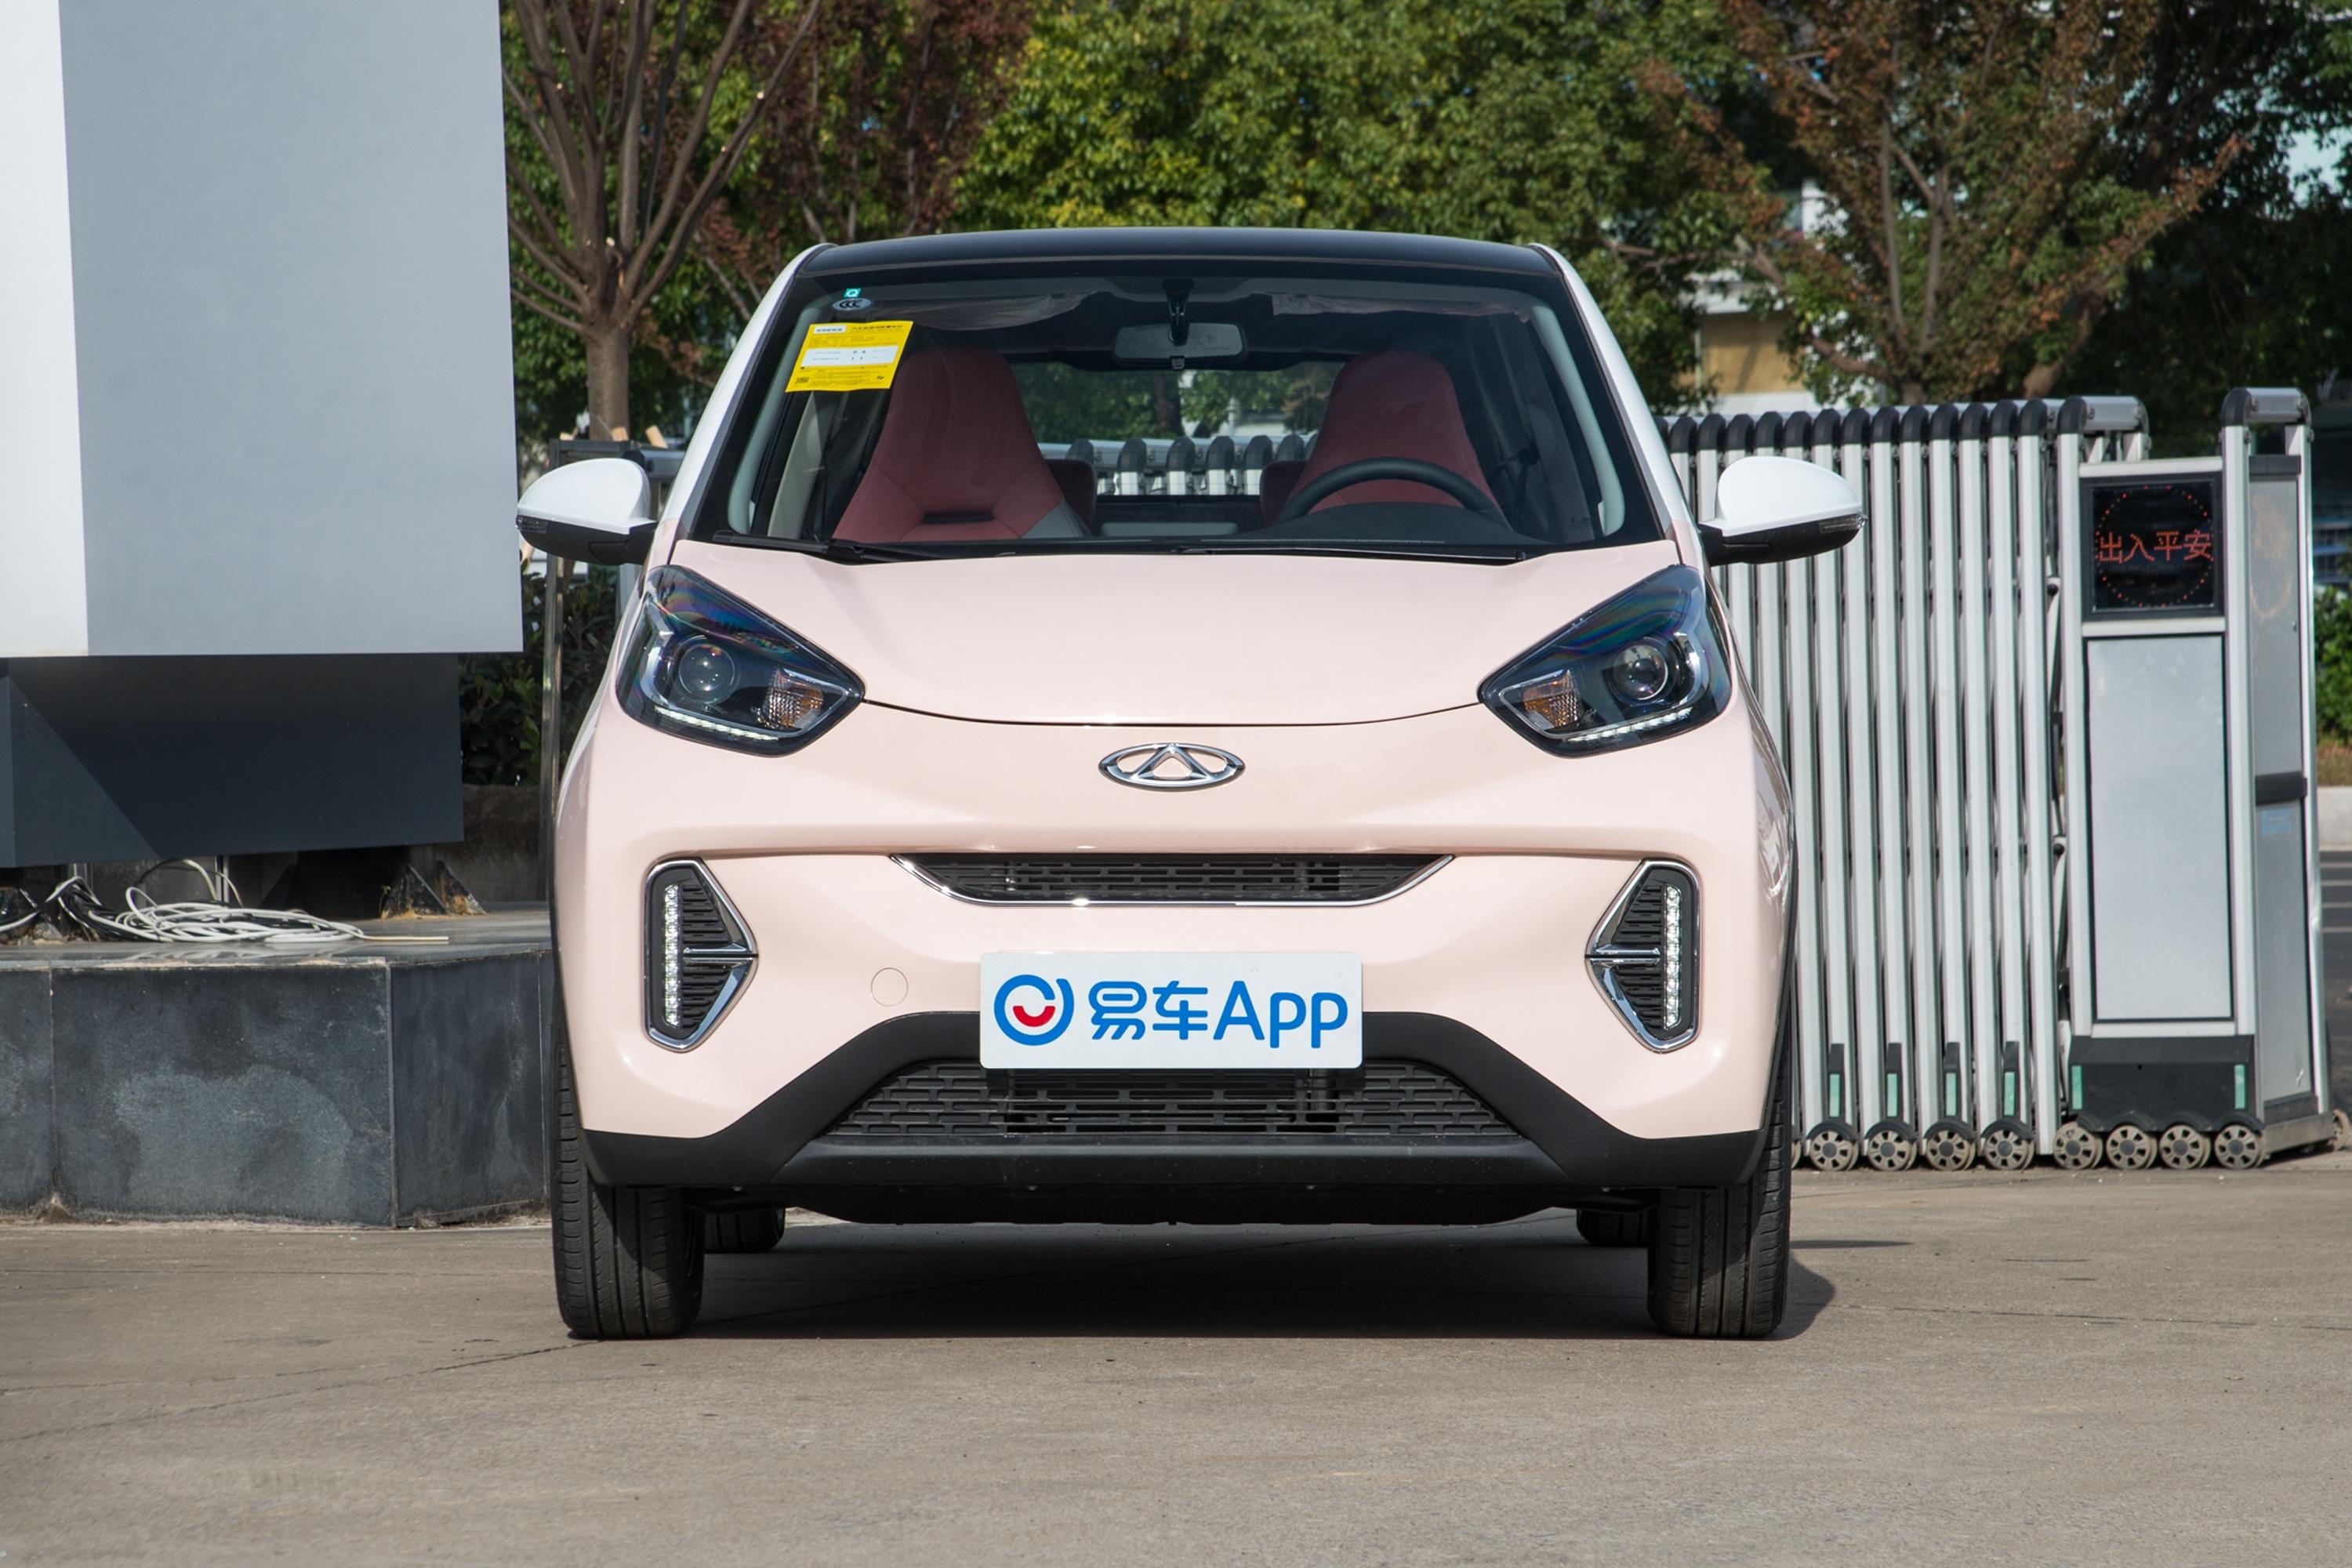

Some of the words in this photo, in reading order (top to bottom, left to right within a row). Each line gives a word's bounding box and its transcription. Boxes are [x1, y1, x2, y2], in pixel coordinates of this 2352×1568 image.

[2099, 528, 2215, 564] 出入平安
[1088, 981, 1348, 1048] 易车App
